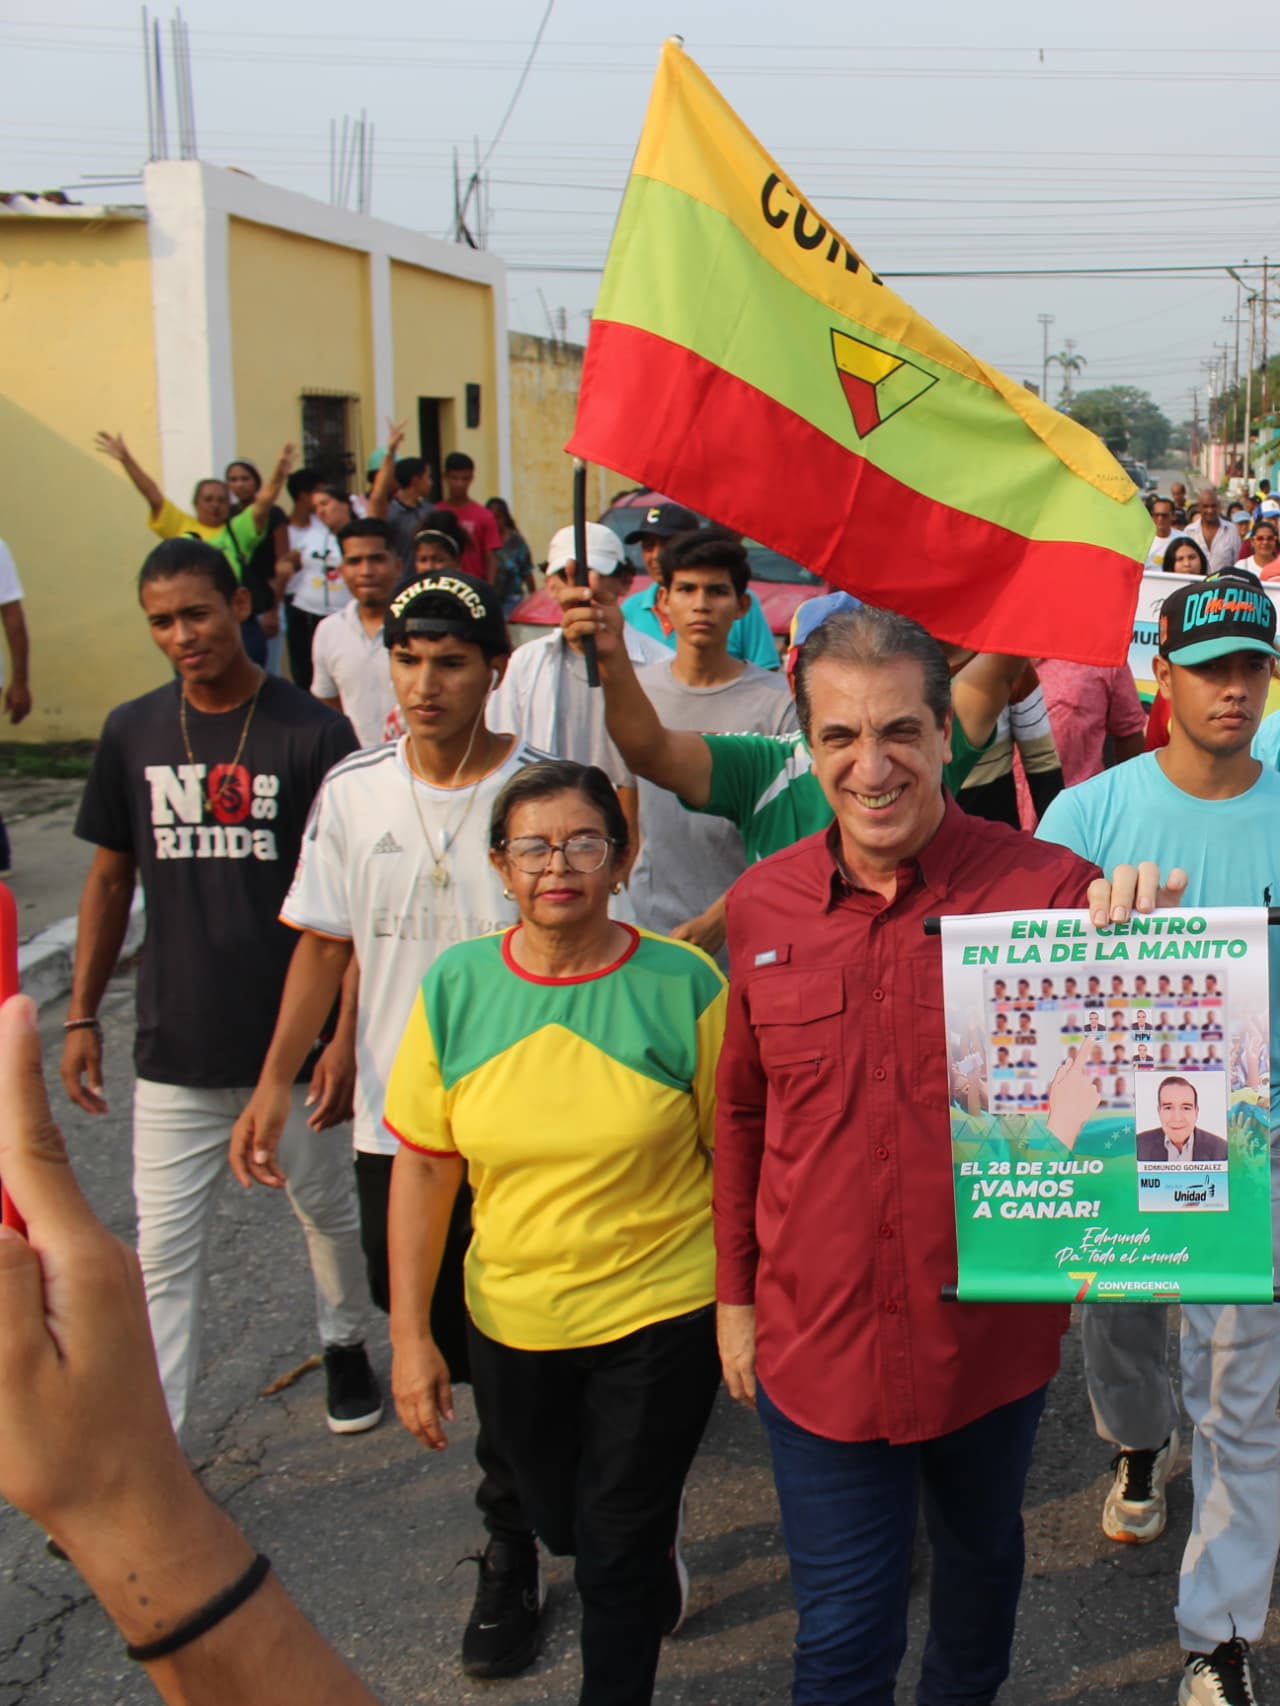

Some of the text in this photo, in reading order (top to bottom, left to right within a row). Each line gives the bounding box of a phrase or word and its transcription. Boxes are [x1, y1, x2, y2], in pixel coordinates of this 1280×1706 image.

[390, 576, 486, 619] ATHLETICS
[1183, 587, 1271, 633] DOLPHINS
[1011, 920, 1048, 939] EN
[1055, 920, 1087, 938] EL
[962, 939, 1248, 965] EN LA DE LA MANITO
[960, 1160, 1104, 1176] EL 28 DE JULIO
[972, 1180, 1074, 1201] ¡VAMOS
[1141, 1178, 1161, 1189] MUD
[1174, 1189, 1207, 1202] Unidad
[973, 1200, 1101, 1219] A GANAR!
[1080, 1226, 1151, 1249] Edmundo
[1119, 1248, 1139, 1264] el
[1142, 1247, 1189, 1265] mundo
[1097, 1281, 1180, 1290] CONVERGENCIA
